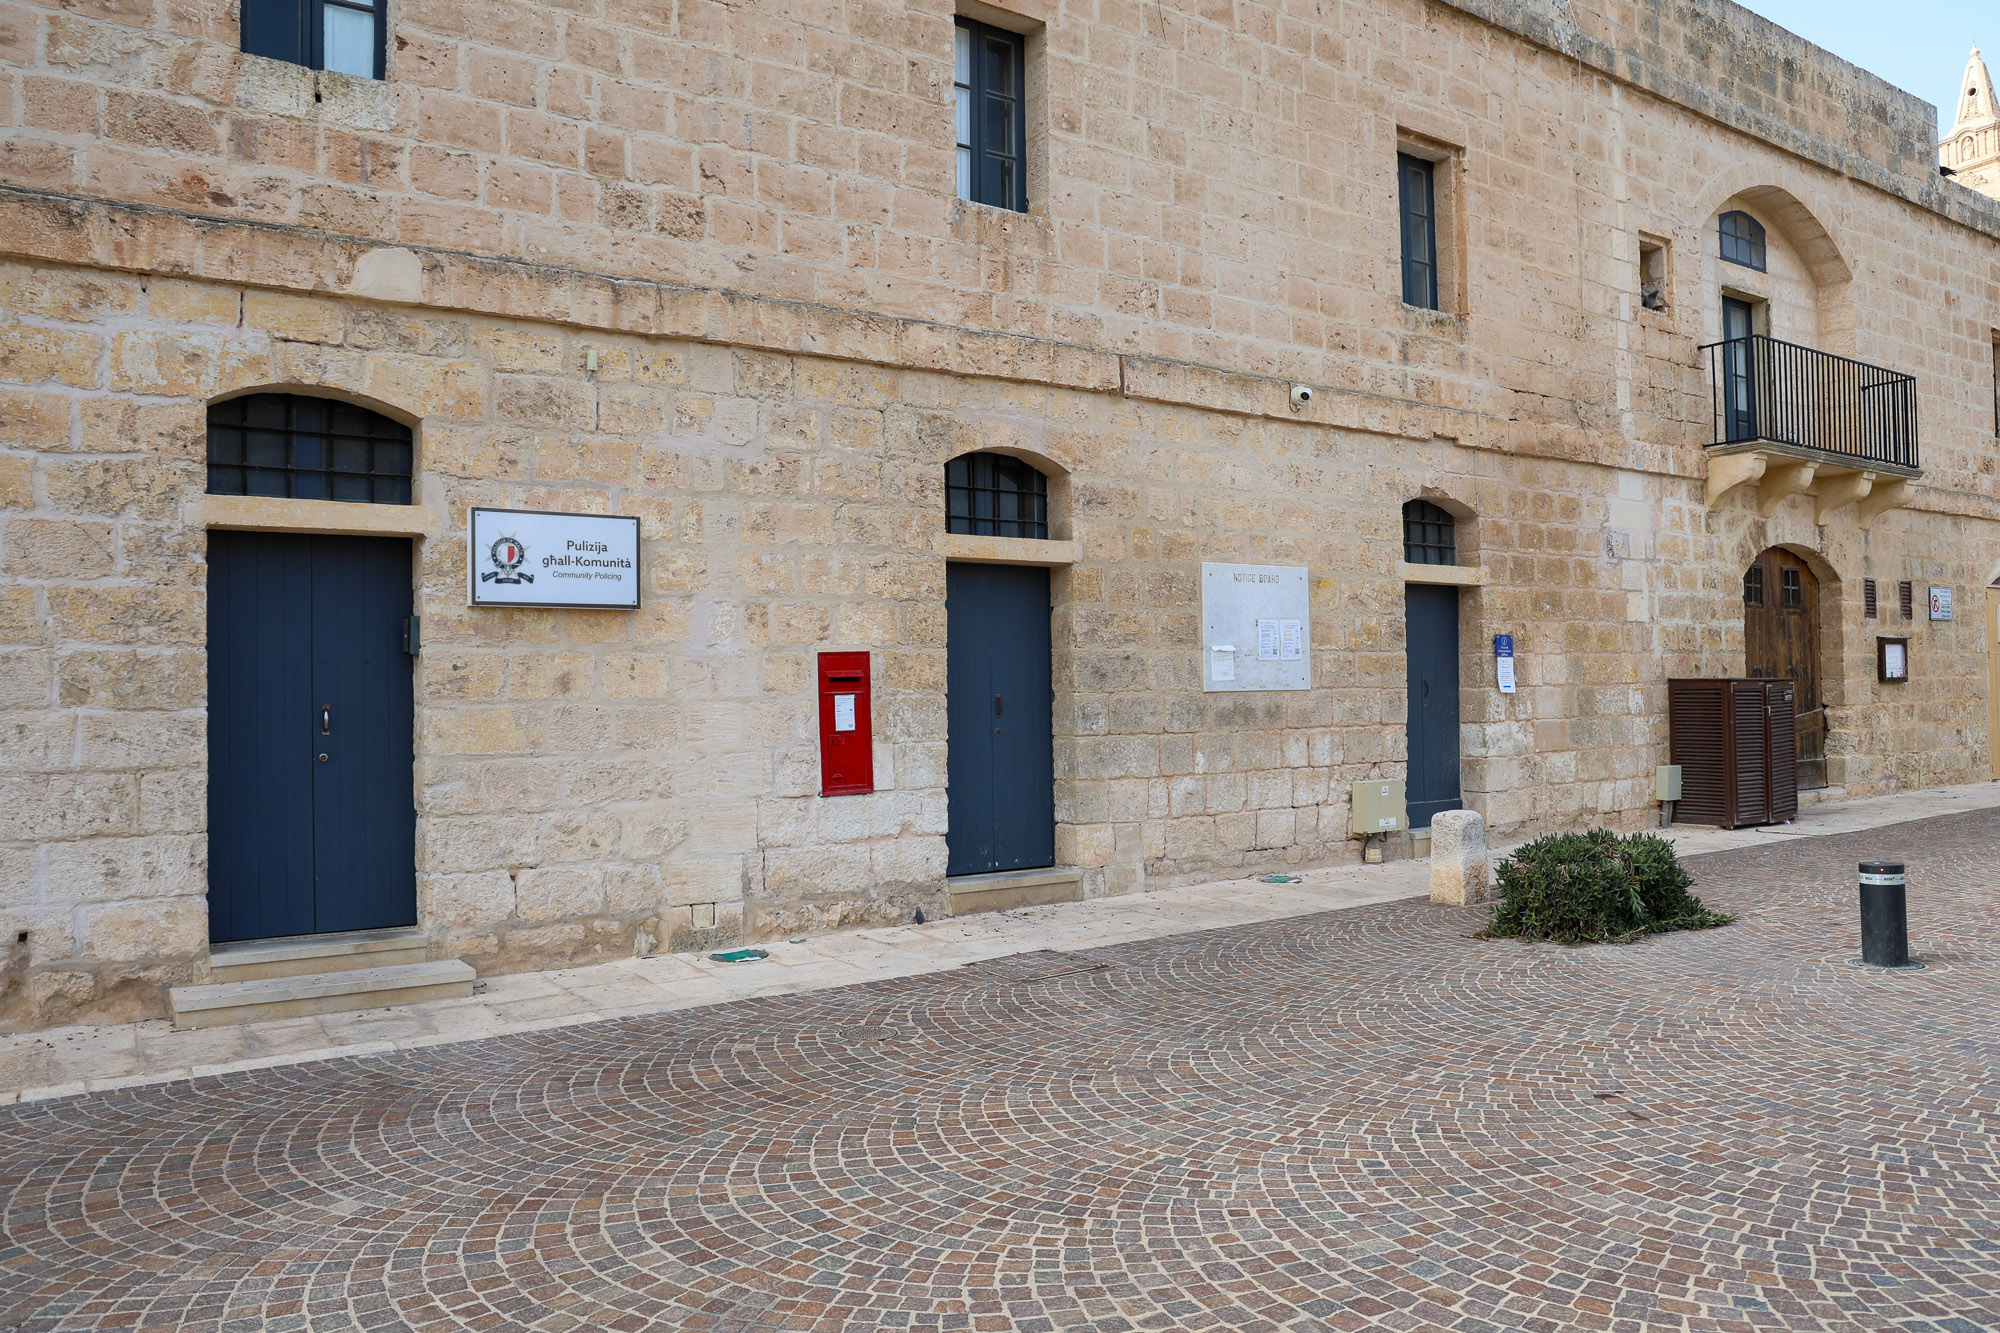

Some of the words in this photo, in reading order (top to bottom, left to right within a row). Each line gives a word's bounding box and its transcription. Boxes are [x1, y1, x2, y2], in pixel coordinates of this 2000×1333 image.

[567, 540, 608, 554] Pulizija
[542, 554, 632, 569] għall-Komunità
[552, 571, 593, 581] Community
[594, 572, 622, 581] Policing
[1233, 573, 1256, 583] NOTICE
[1259, 574, 1280, 584] BOARD
